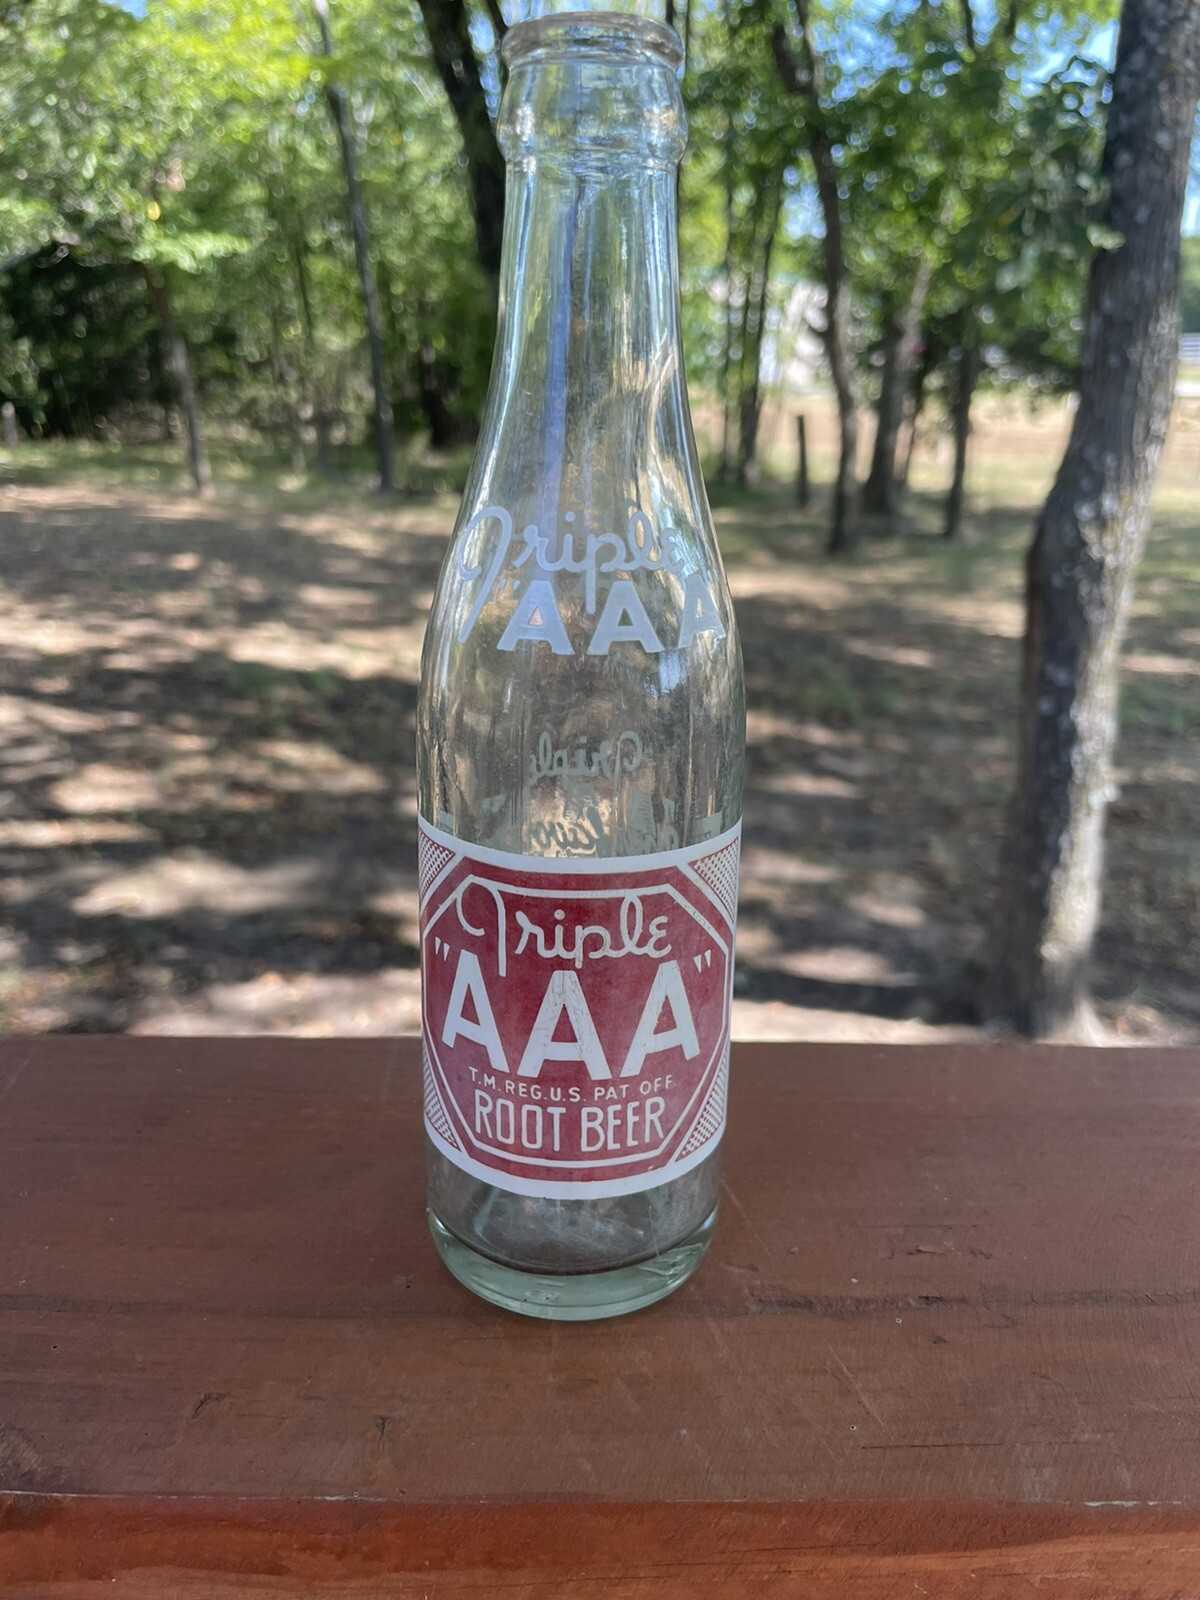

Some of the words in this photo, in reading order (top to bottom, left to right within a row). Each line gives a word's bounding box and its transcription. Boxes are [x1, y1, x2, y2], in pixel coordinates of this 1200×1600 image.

[457, 506, 686, 643] Triple
[456, 876, 672, 977] Triple
[475, 1089, 567, 1152] ROOT
[580, 1096, 666, 1153] BEER
[594, 1084, 630, 1101] PAT
